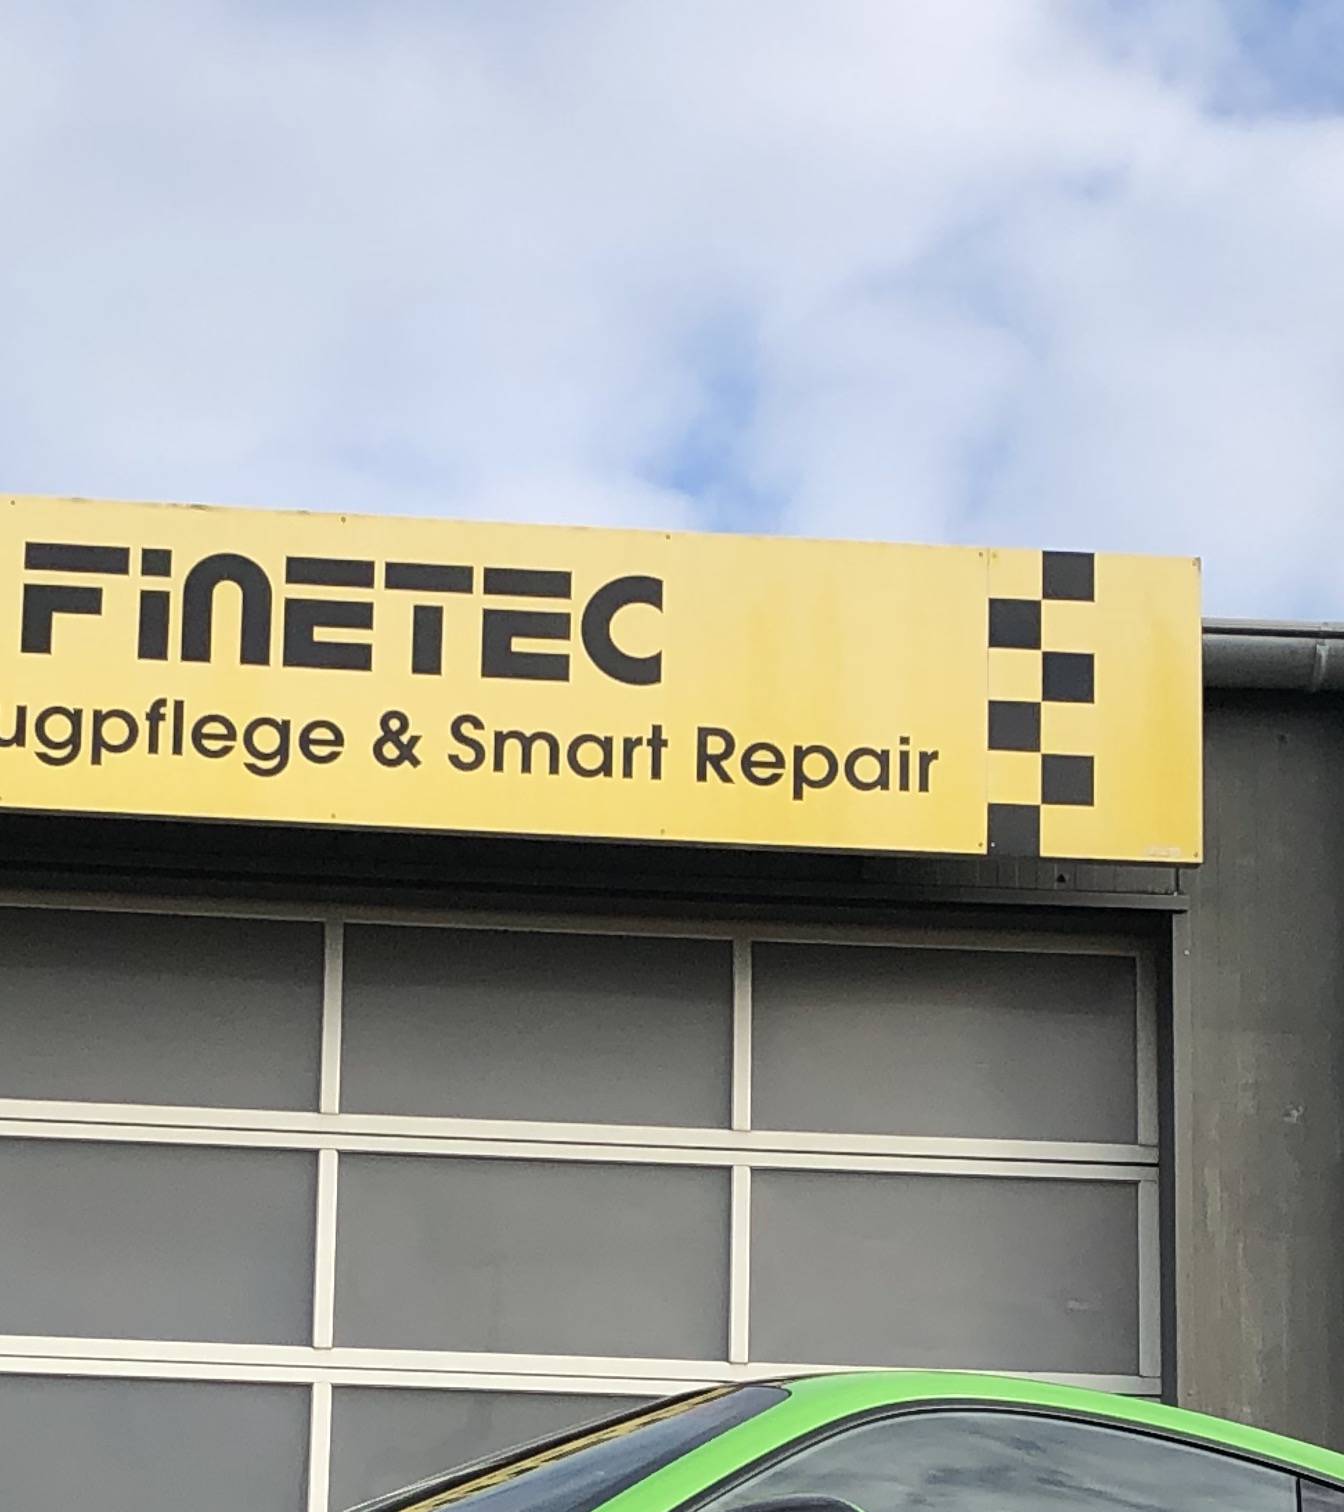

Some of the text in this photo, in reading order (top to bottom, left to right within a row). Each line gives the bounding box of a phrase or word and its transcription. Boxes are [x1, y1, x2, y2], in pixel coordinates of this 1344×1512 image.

[372, 709, 423, 769] &
[447, 713, 669, 781] Smart
[696, 726, 940, 801] Repair
